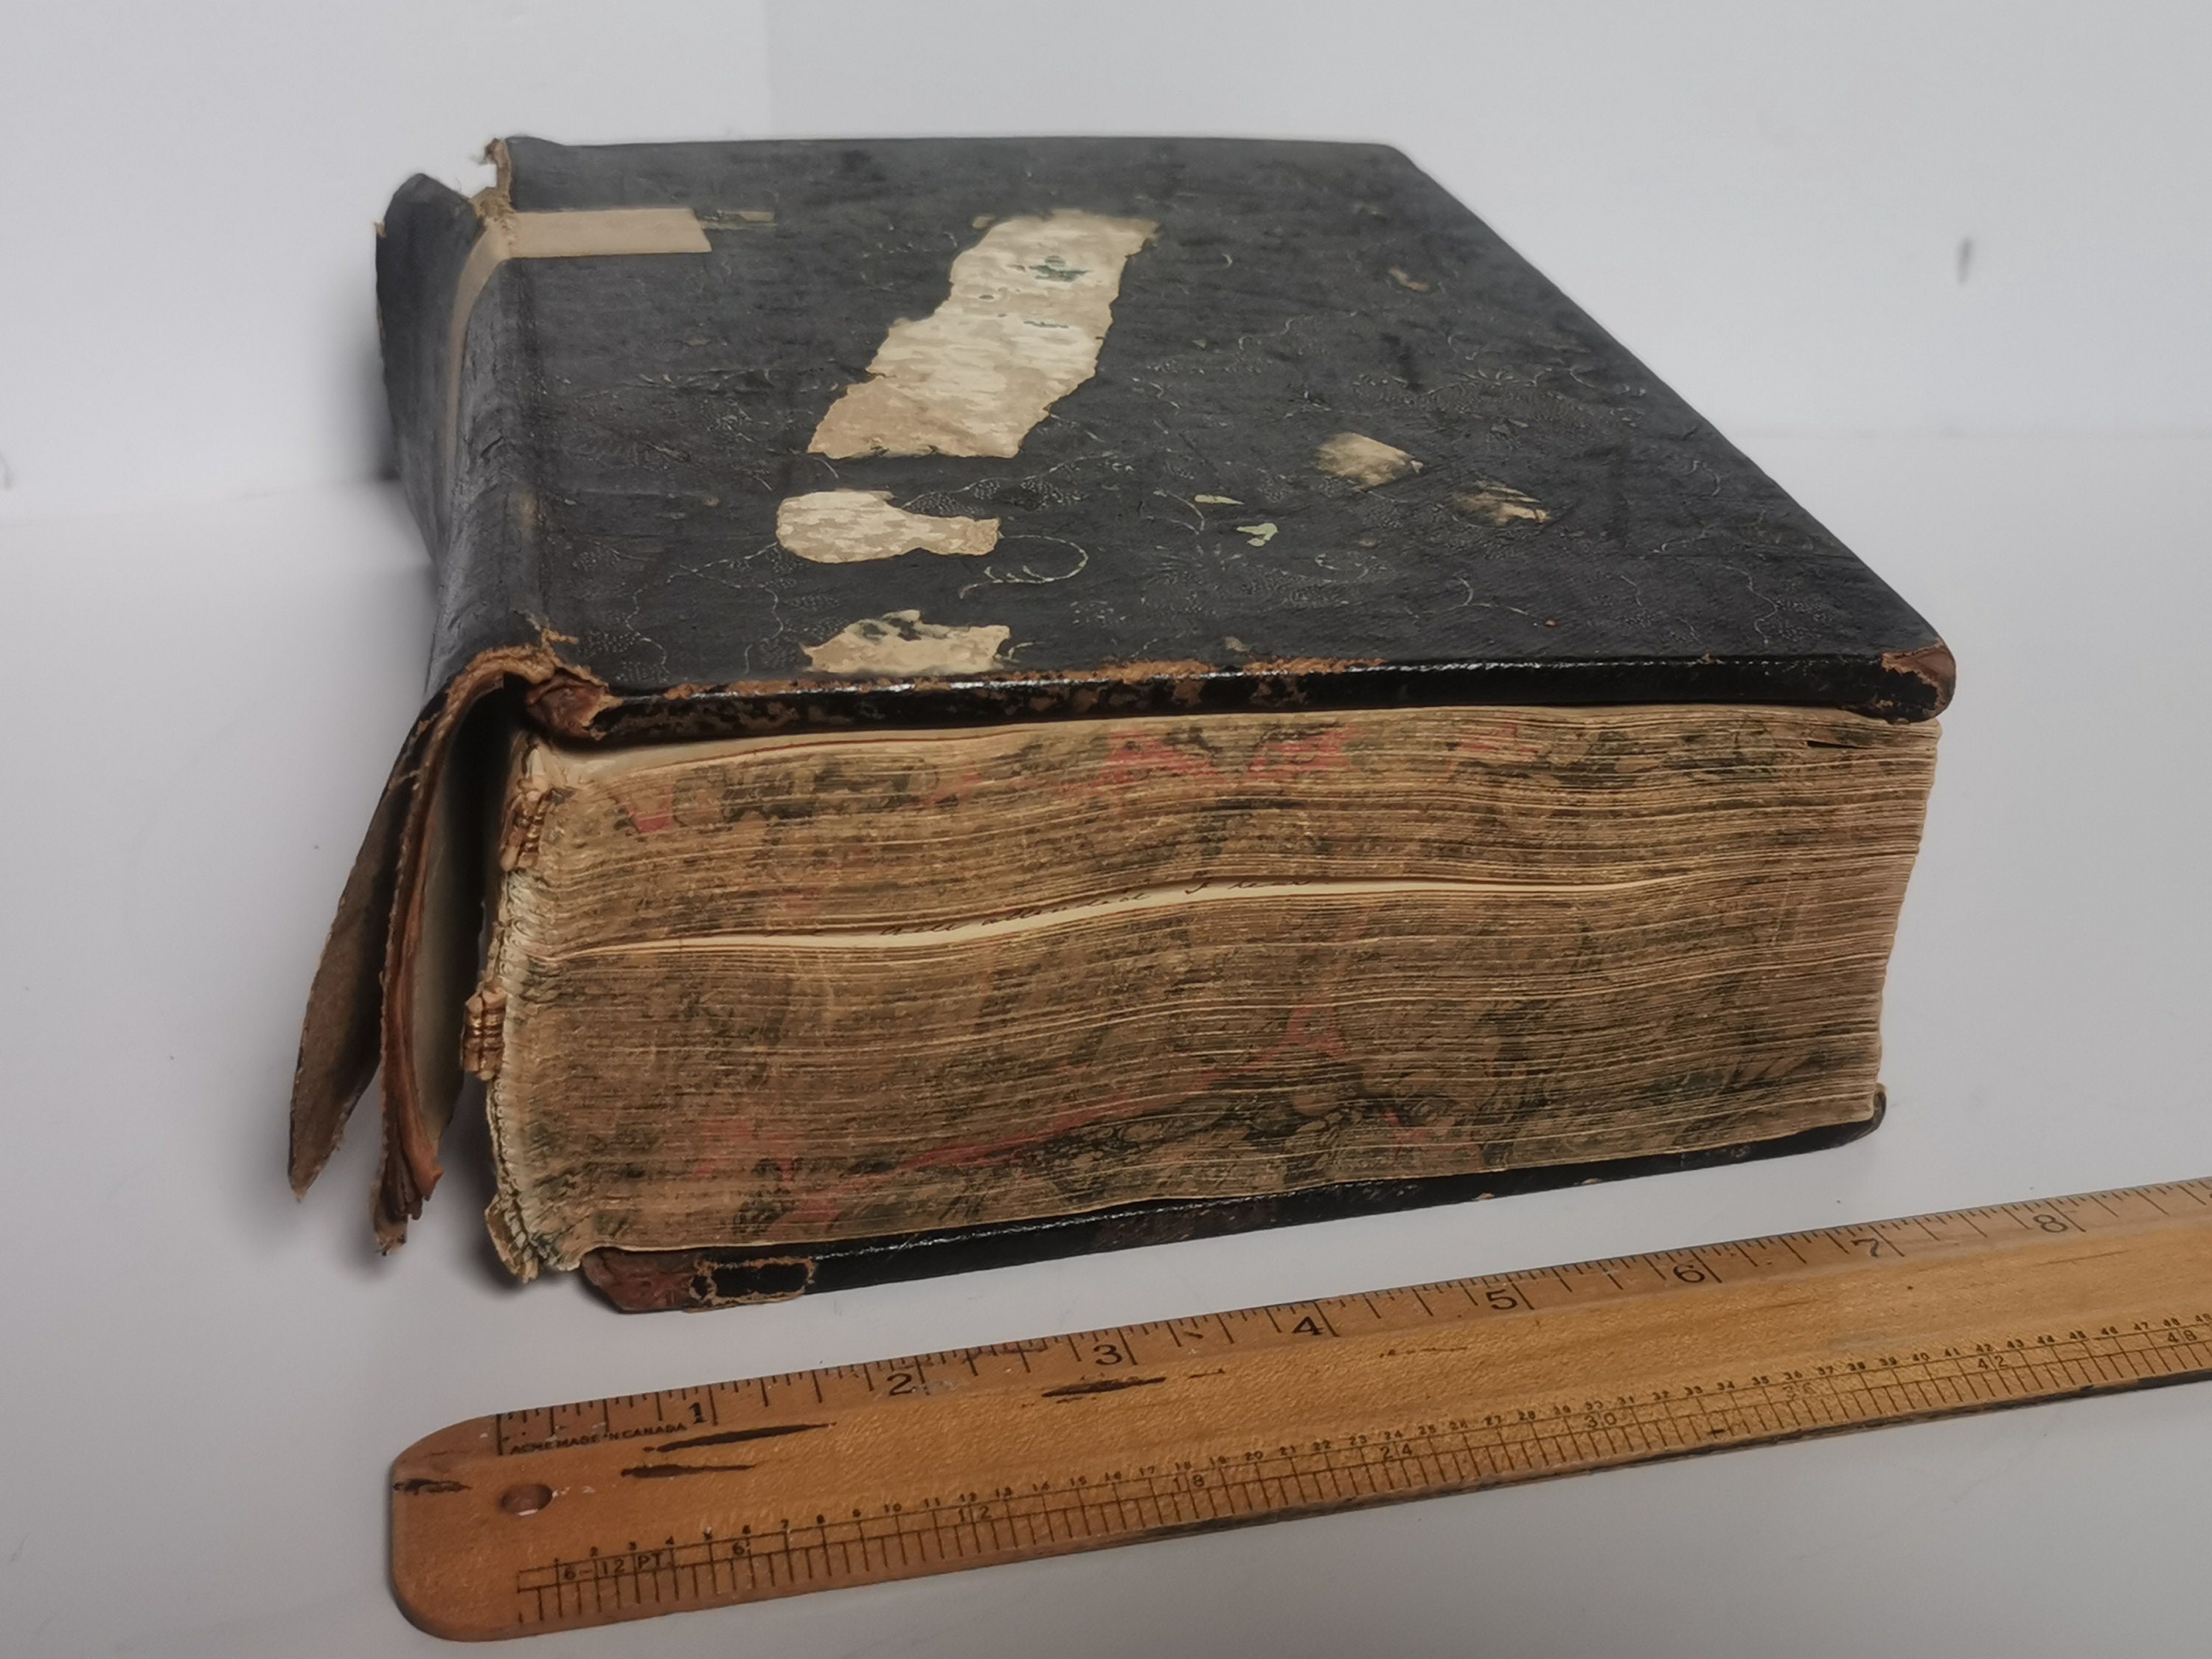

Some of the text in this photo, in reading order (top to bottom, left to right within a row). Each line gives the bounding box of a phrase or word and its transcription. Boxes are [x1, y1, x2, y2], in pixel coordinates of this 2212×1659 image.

[689, 1214, 2068, 1424] 1 2 3 4 5 6 7 8
[556, 1433, 600, 1448] MADE
[622, 1422, 687, 1439] CANADA
[665, 1536, 674, 1545] 4
[781, 1519, 789, 1528] 7
[884, 1503, 901, 1512] 10
[925, 1498, 940, 1507] 11
[959, 1492, 977, 1502] 12
[1071, 1475, 1087, 1486] 15
[1139, 1466, 1155, 1475] 17
[1175, 1461, 1192, 1470] 18
[1210, 1456, 1227, 1466] 19
[1246, 1450, 1262, 1461] 20
[1280, 1446, 1295, 1455] 21
[1314, 1440, 1331, 1450] 22
[1349, 1435, 1367, 1445] 23
[1385, 1430, 1402, 1439] 24
[1419, 1425, 1436, 1435] 25
[1450, 1420, 1468, 1430] 26
[1485, 1415, 1502, 1426] 27
[1518, 1409, 1536, 1420] 28
[1554, 1405, 1571, 1415] 29
[1618, 1396, 1634, 1404] 31
[1652, 1391, 1669, 1399] 32
[1685, 1386, 1703, 1395] 33
[1717, 1381, 1735, 1391] 34
[1752, 1376, 1769, 1385] 35
[1784, 1371, 1803, 1380] 36
[1818, 1366, 1834, 1375] 37
[1848, 1361, 1865, 1371] 38
[1879, 1357, 1897, 1366] 39
[1913, 1352, 1930, 1362] 40
[1944, 1348, 1960, 1357] 41
[1976, 1343, 1993, 1352] 42
[2007, 1338, 2024, 1349] 43
[2037, 1335, 2055, 1344] 44
[2069, 1330, 2087, 1340] 45
[2101, 1326, 2118, 1335] 46
[2134, 1321, 2149, 1331] 47
[2164, 1318, 2180, 1326] 48
[2195, 1313, 2212, 1322] 49
[959, 1506, 992, 1523] 12
[1173, 1474, 1204, 1491] 18
[1380, 1443, 1413, 1461] 24
[1585, 1412, 1617, 1428] 30
[1782, 1383, 1815, 1401] 36
[1978, 1355, 2008, 1370] 42
[2167, 1329, 2197, 1343] 48
